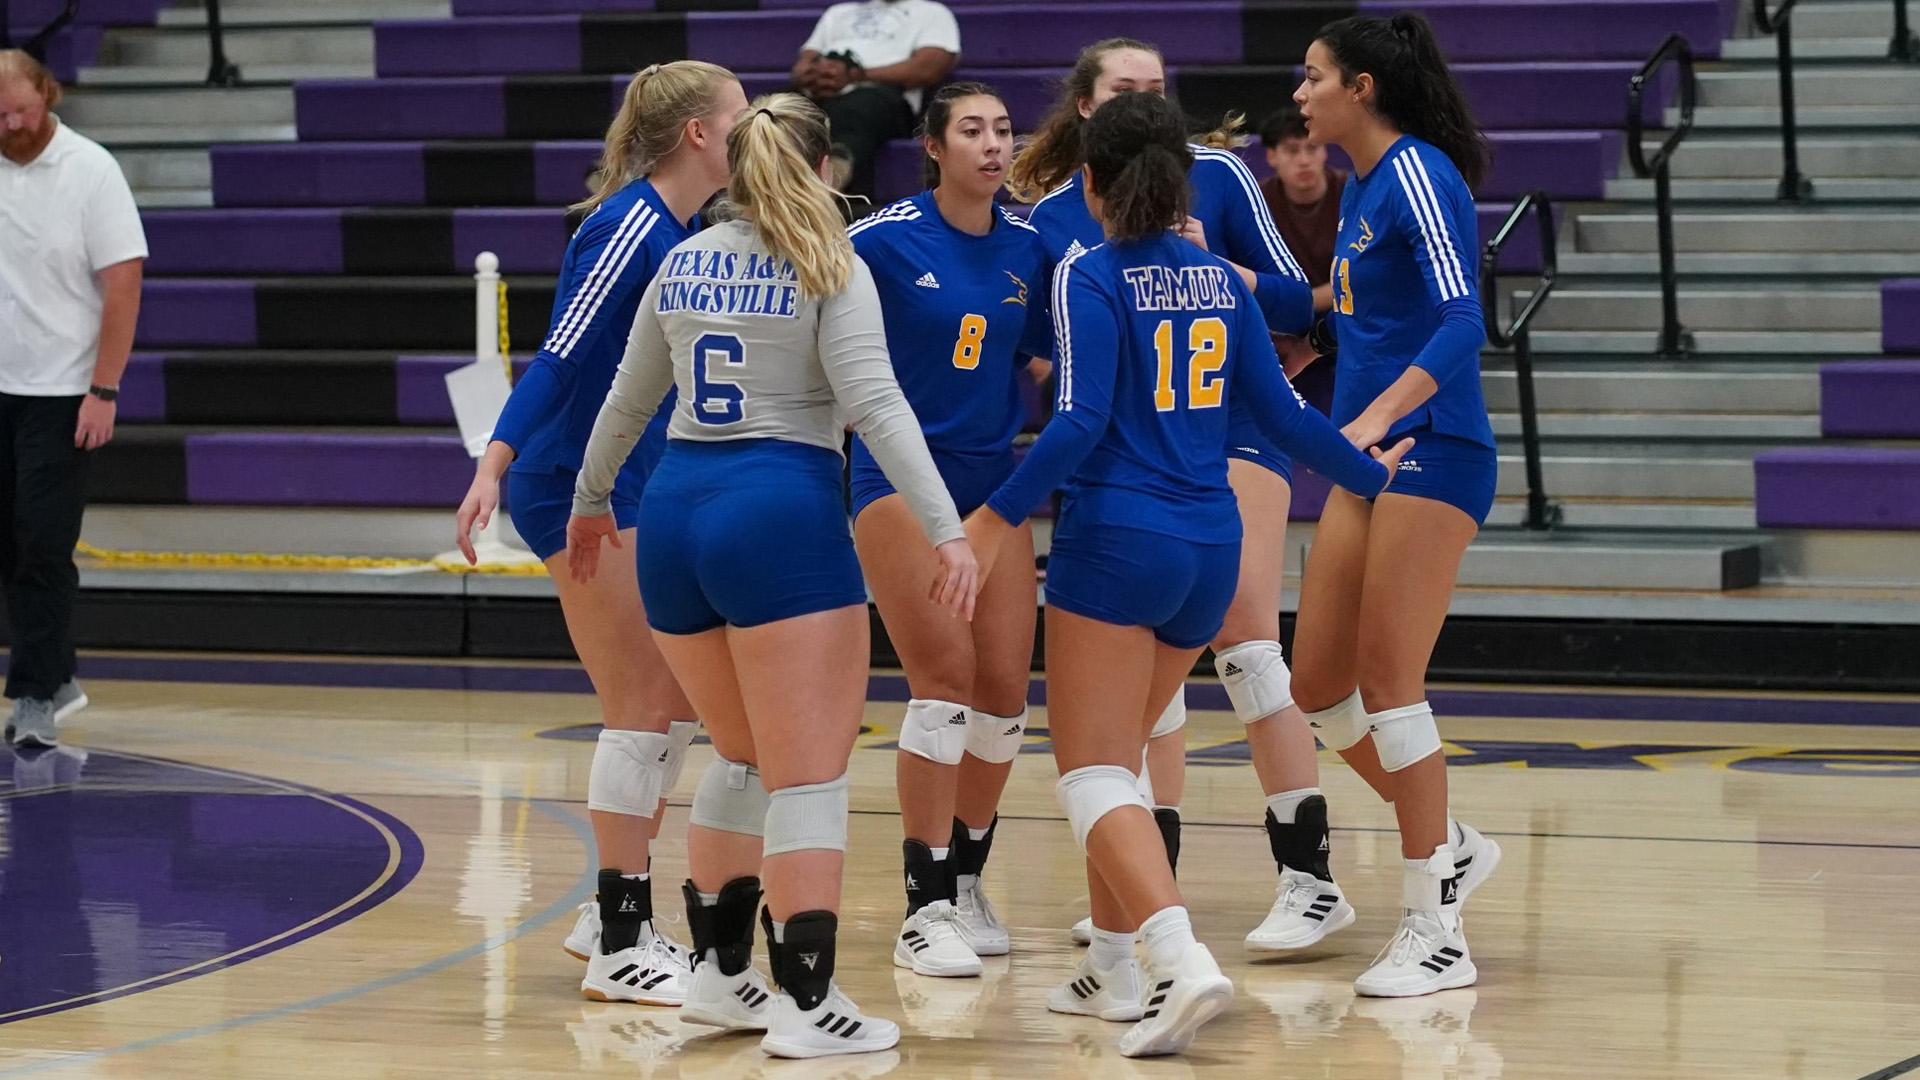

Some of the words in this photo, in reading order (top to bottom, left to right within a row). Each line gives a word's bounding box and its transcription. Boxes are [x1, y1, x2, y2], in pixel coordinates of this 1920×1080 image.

[665, 250, 738, 280] TEXAS
[1123, 265, 1235, 311] TAMUK
[656, 281, 798, 317] KINGSVILLE
[952, 313, 987, 370] 8
[1154, 317, 1227, 412] 12
[692, 330, 747, 424] 6
